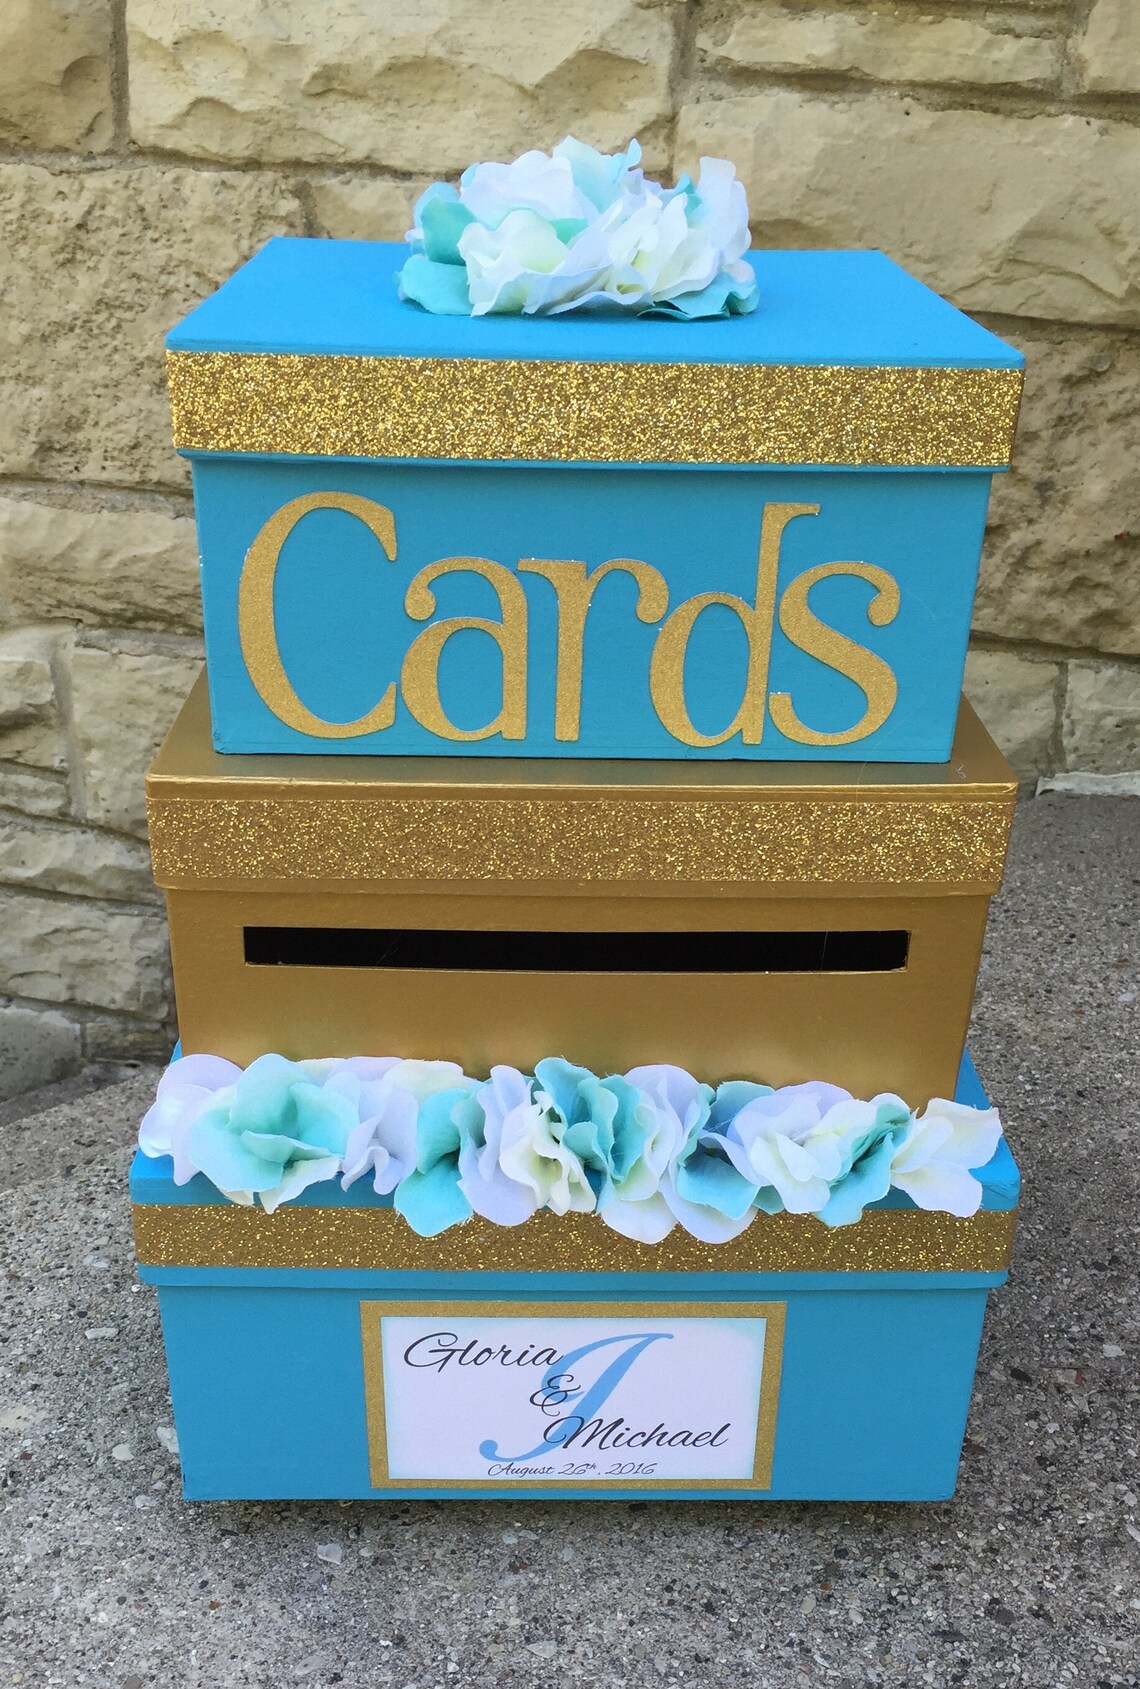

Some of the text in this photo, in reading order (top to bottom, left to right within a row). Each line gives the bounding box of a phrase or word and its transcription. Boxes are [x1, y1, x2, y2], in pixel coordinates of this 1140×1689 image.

[238, 490, 901, 747] Cards
[403, 1331, 564, 1372] Gloria
[528, 1374, 581, 1416] &
[543, 1415, 730, 1450] Michael
[487, 1462, 555, 1478] August
[605, 1462, 658, 1476] 2016
